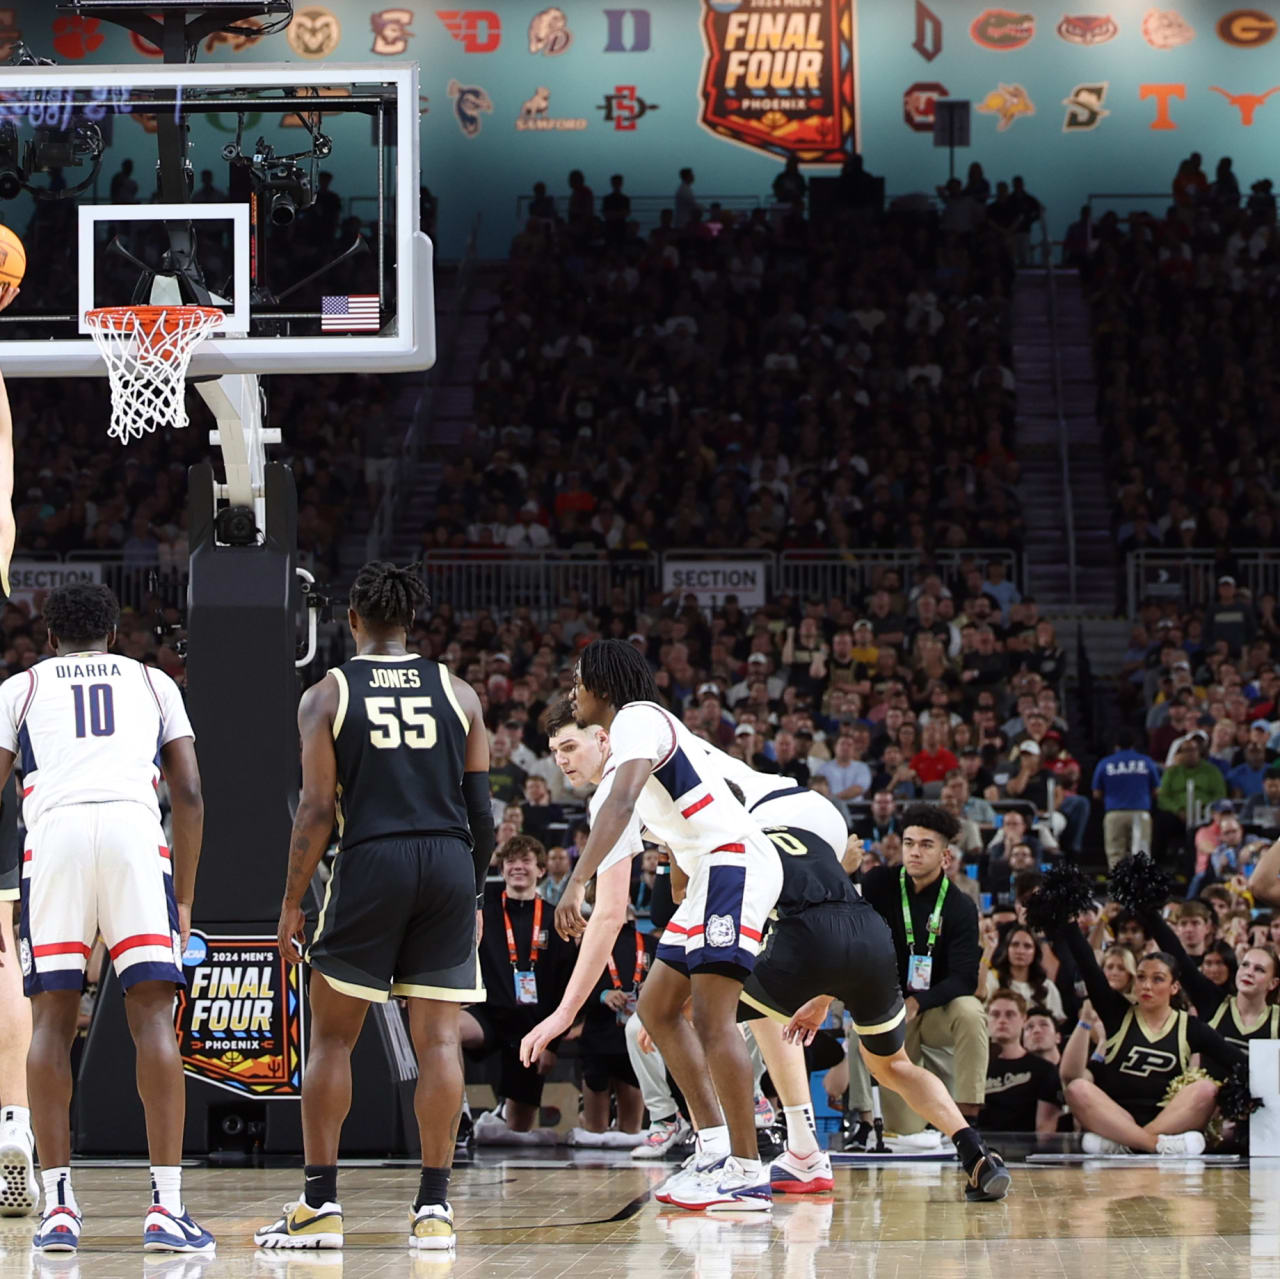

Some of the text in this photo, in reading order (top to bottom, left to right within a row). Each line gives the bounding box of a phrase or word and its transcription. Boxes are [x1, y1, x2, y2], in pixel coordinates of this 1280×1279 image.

[724, 12, 824, 51] FINAL
[724, 50, 824, 89] FOUR
[741, 99, 807, 110] PHOENIX
[11, 570, 94, 588] SECTION
[672, 569, 757, 587] SECTION
[56, 663, 122, 678] DIARRA
[369, 668, 421, 688] JONES
[70, 683, 115, 738] 10
[364, 696, 437, 749] 55
[766, 832, 808, 855] 0
[212, 951, 274, 962] 2024 MEN'S
[190, 967, 275, 999] FINAL
[191, 999, 274, 1031] FOUR
[205, 1040, 260, 1050] PHOENIX
